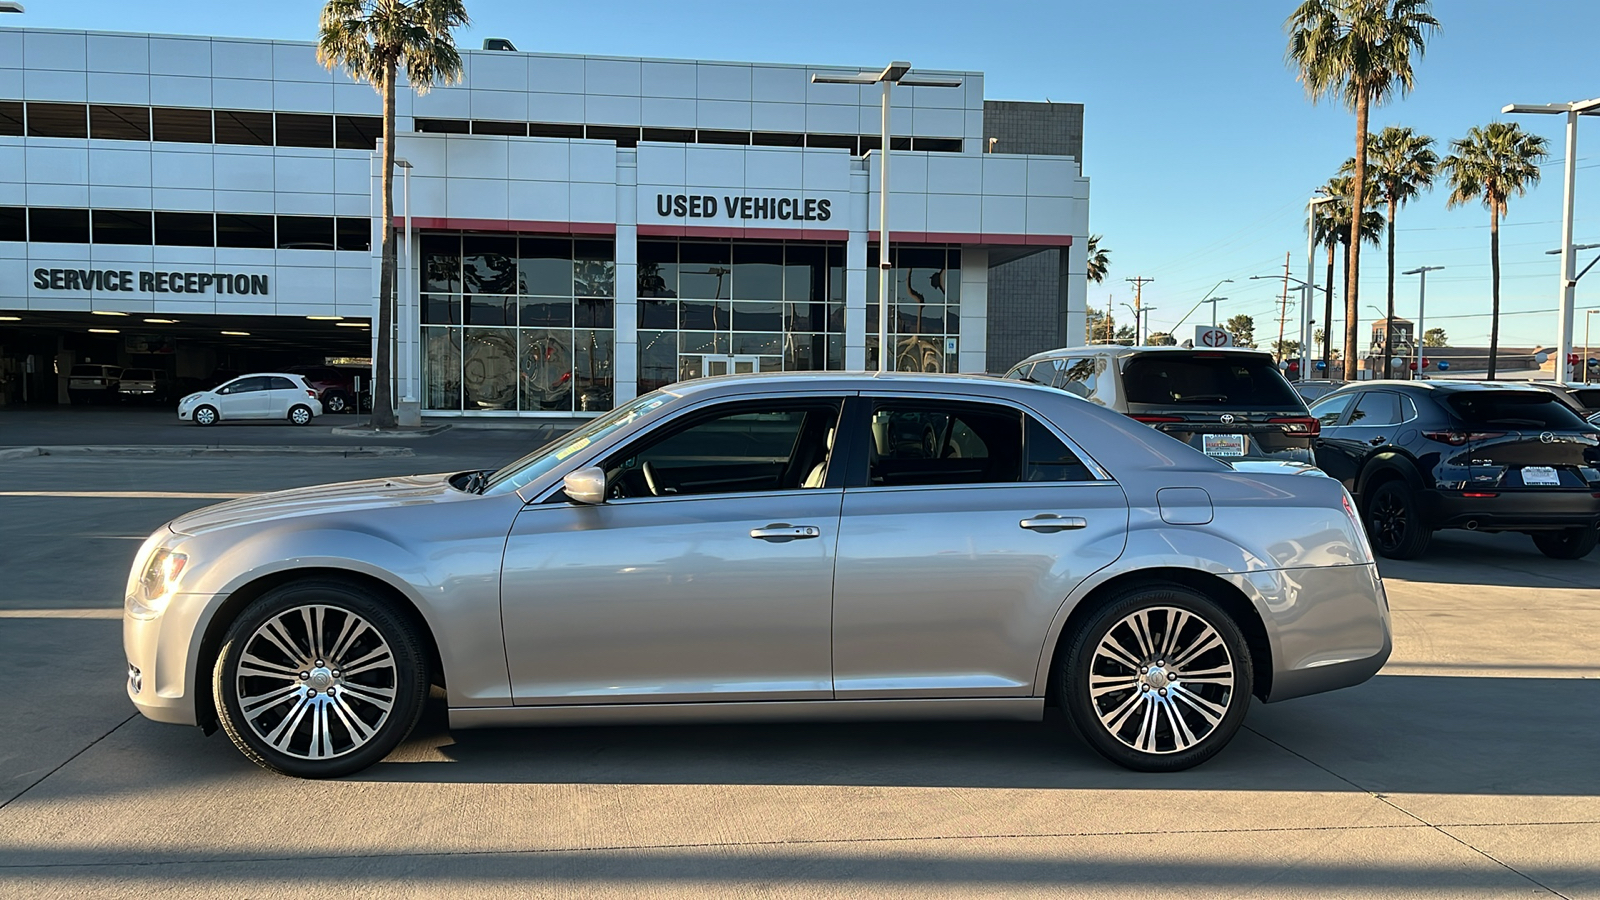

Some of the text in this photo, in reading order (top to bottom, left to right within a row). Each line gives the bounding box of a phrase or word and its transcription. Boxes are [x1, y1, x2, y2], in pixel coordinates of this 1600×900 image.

[657, 194, 831, 222] USED VEHICLES
[33, 268, 269, 296] SERVICE RECEPTION
